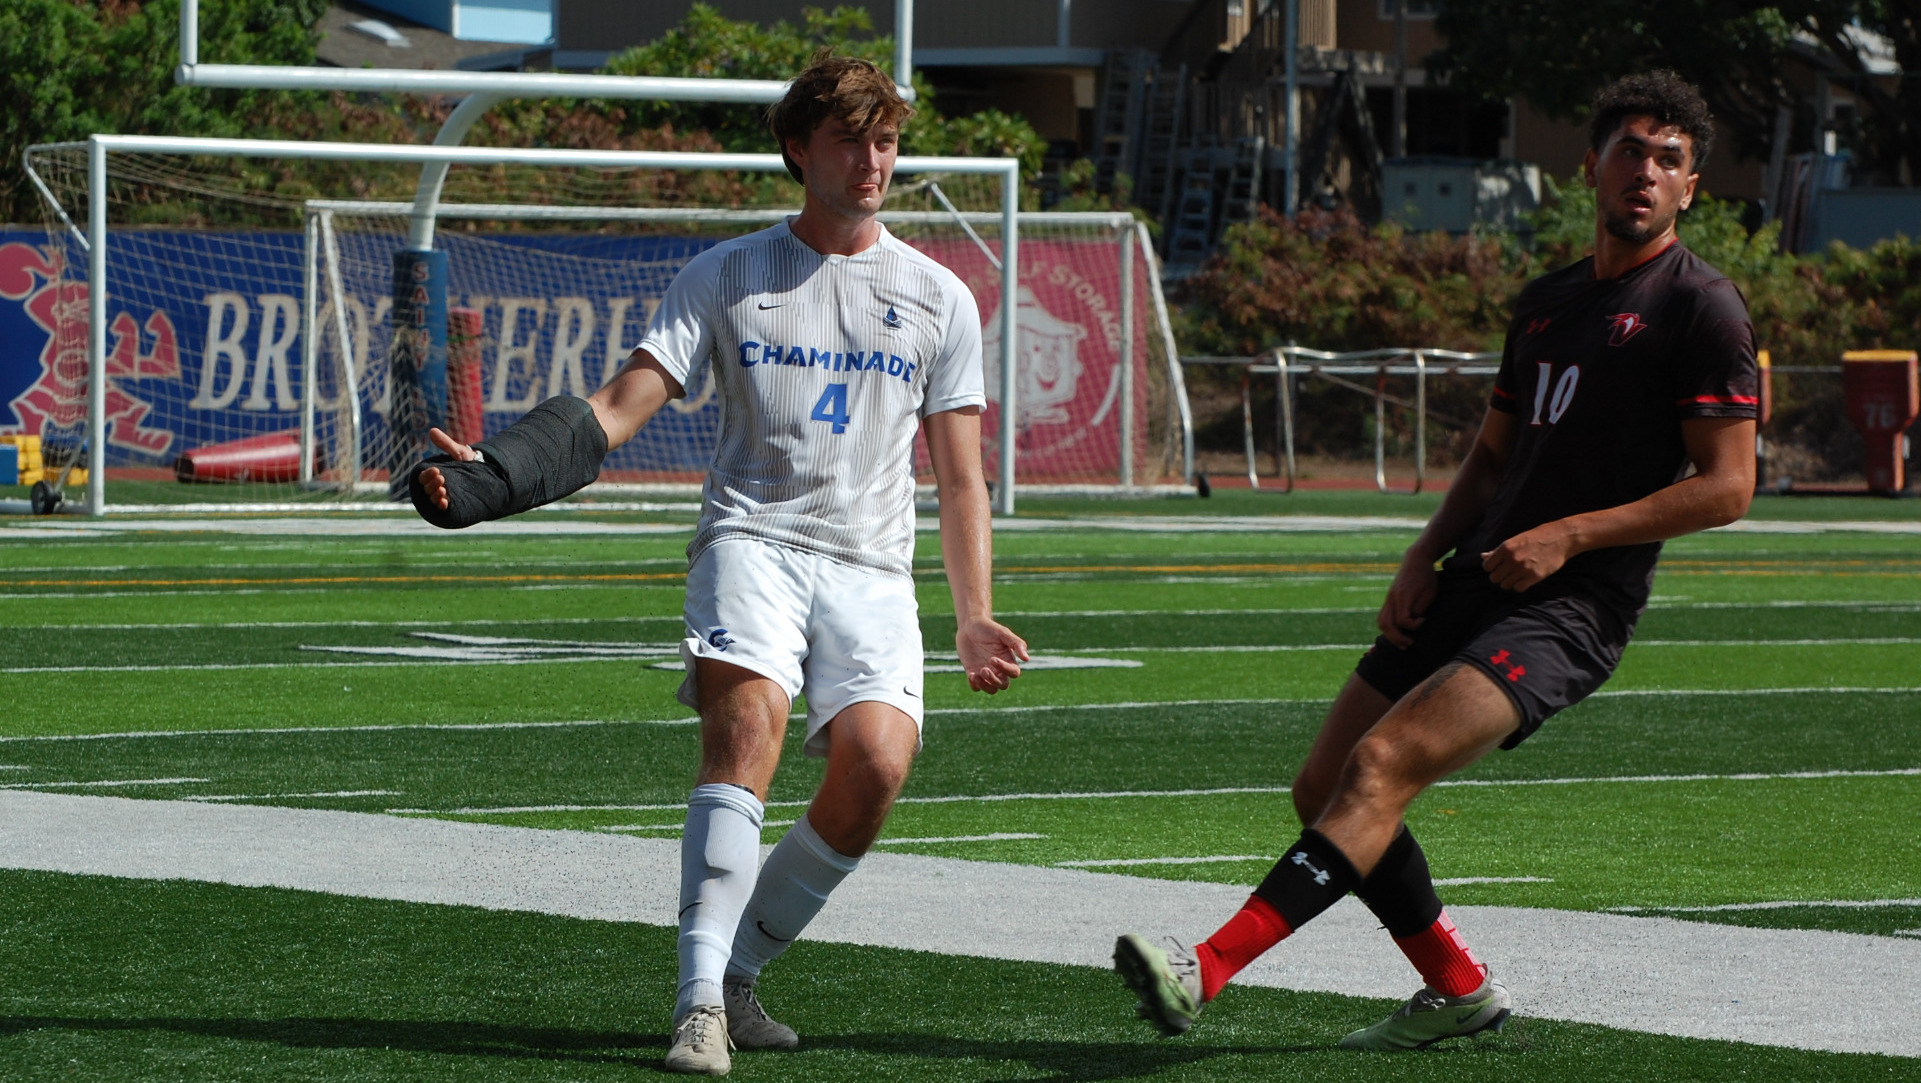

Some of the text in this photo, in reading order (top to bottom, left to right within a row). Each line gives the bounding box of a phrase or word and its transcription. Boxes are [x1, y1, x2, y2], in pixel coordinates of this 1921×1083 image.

[738, 340, 916, 383] CHAMINADE
[811, 382, 850, 435] 4
[1530, 361, 1581, 426] 10
